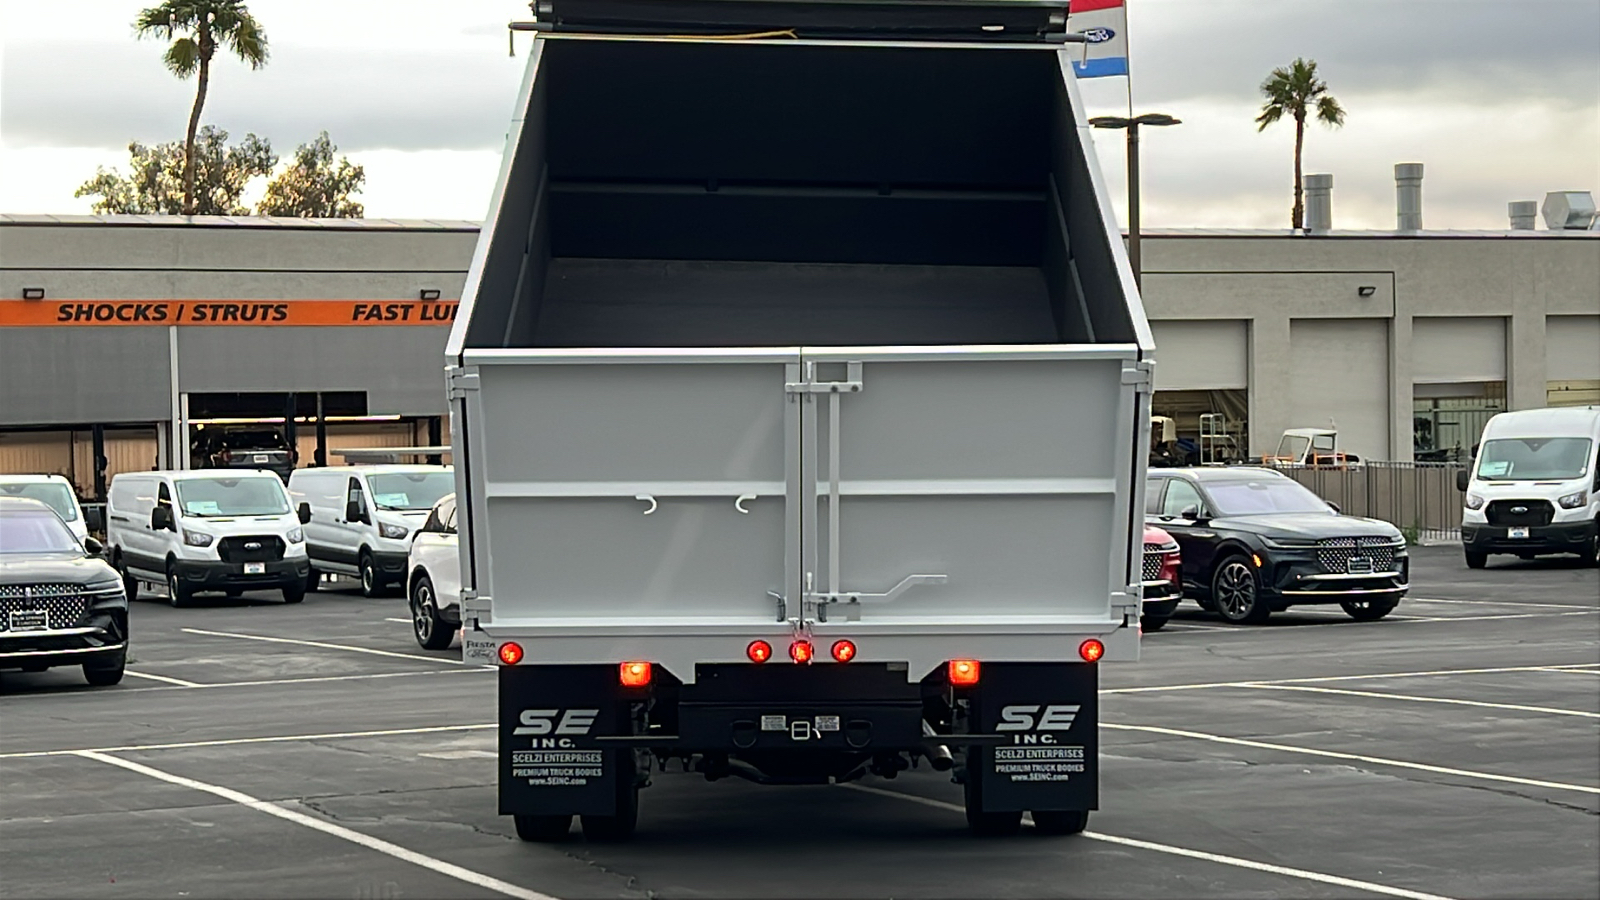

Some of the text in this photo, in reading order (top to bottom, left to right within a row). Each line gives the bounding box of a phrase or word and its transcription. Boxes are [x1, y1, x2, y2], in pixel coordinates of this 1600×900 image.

[57, 303, 168, 322] SHOCKS
[191, 303, 289, 322] STRUTS
[352, 304, 415, 321] FAST
[512, 709, 600, 735] SE
[995, 704, 1082, 731] SE
[532, 738, 576, 748] INC.
[1014, 734, 1058, 744] INC.
[512, 754, 602, 763] SCELZI ENTERPRISES
[995, 749, 1084, 759] SCELZI ENTERPRISES
[512, 768, 602, 777] PREMIUM TRUCK BODIES
[995, 764, 1085, 773] PREMIUM TRUCK BODIES
